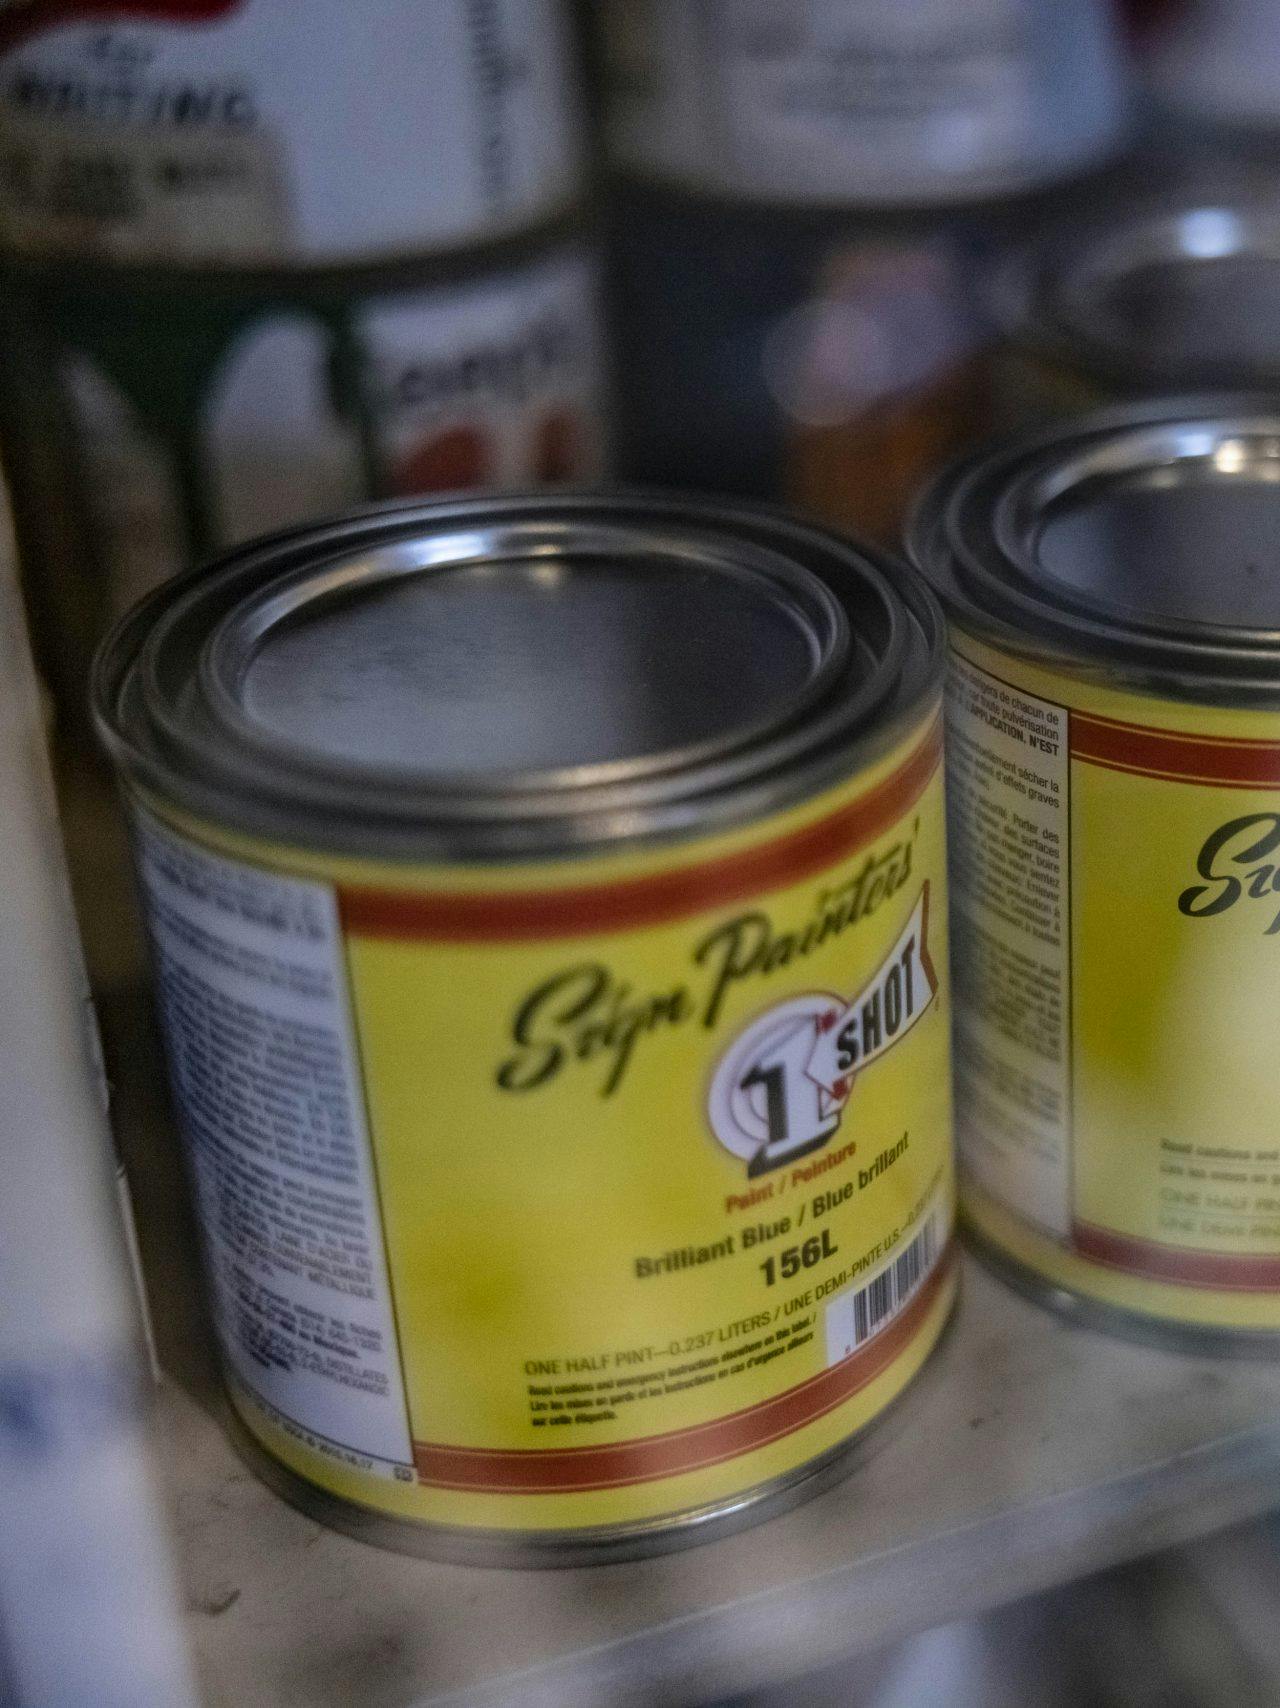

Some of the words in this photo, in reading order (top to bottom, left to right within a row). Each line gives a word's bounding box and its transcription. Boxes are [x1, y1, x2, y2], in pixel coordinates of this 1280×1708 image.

[1029, 732, 1058, 758] N'EST
[1046, 710, 1058, 726] de
[497, 962, 693, 1099] Sign
[695, 815, 921, 1028] Painters'
[835, 935, 916, 1071] SHOT
[633, 1236, 735, 1280] Brilliant
[741, 1215, 792, 1250] Blue
[812, 1181, 854, 1219] Blue
[857, 1130, 910, 1190] brillant
[725, 1187, 774, 1215] Paint
[791, 1141, 857, 1188] Peinture
[759, 1228, 839, 1288] 156L
[524, 1359, 561, 1376] ONE
[566, 1355, 610, 1374] HALF
[718, 1311, 771, 1342] LITERS
[784, 1290, 813, 1316] UNE
[815, 1245, 884, 1301] DEMI-PINTE
